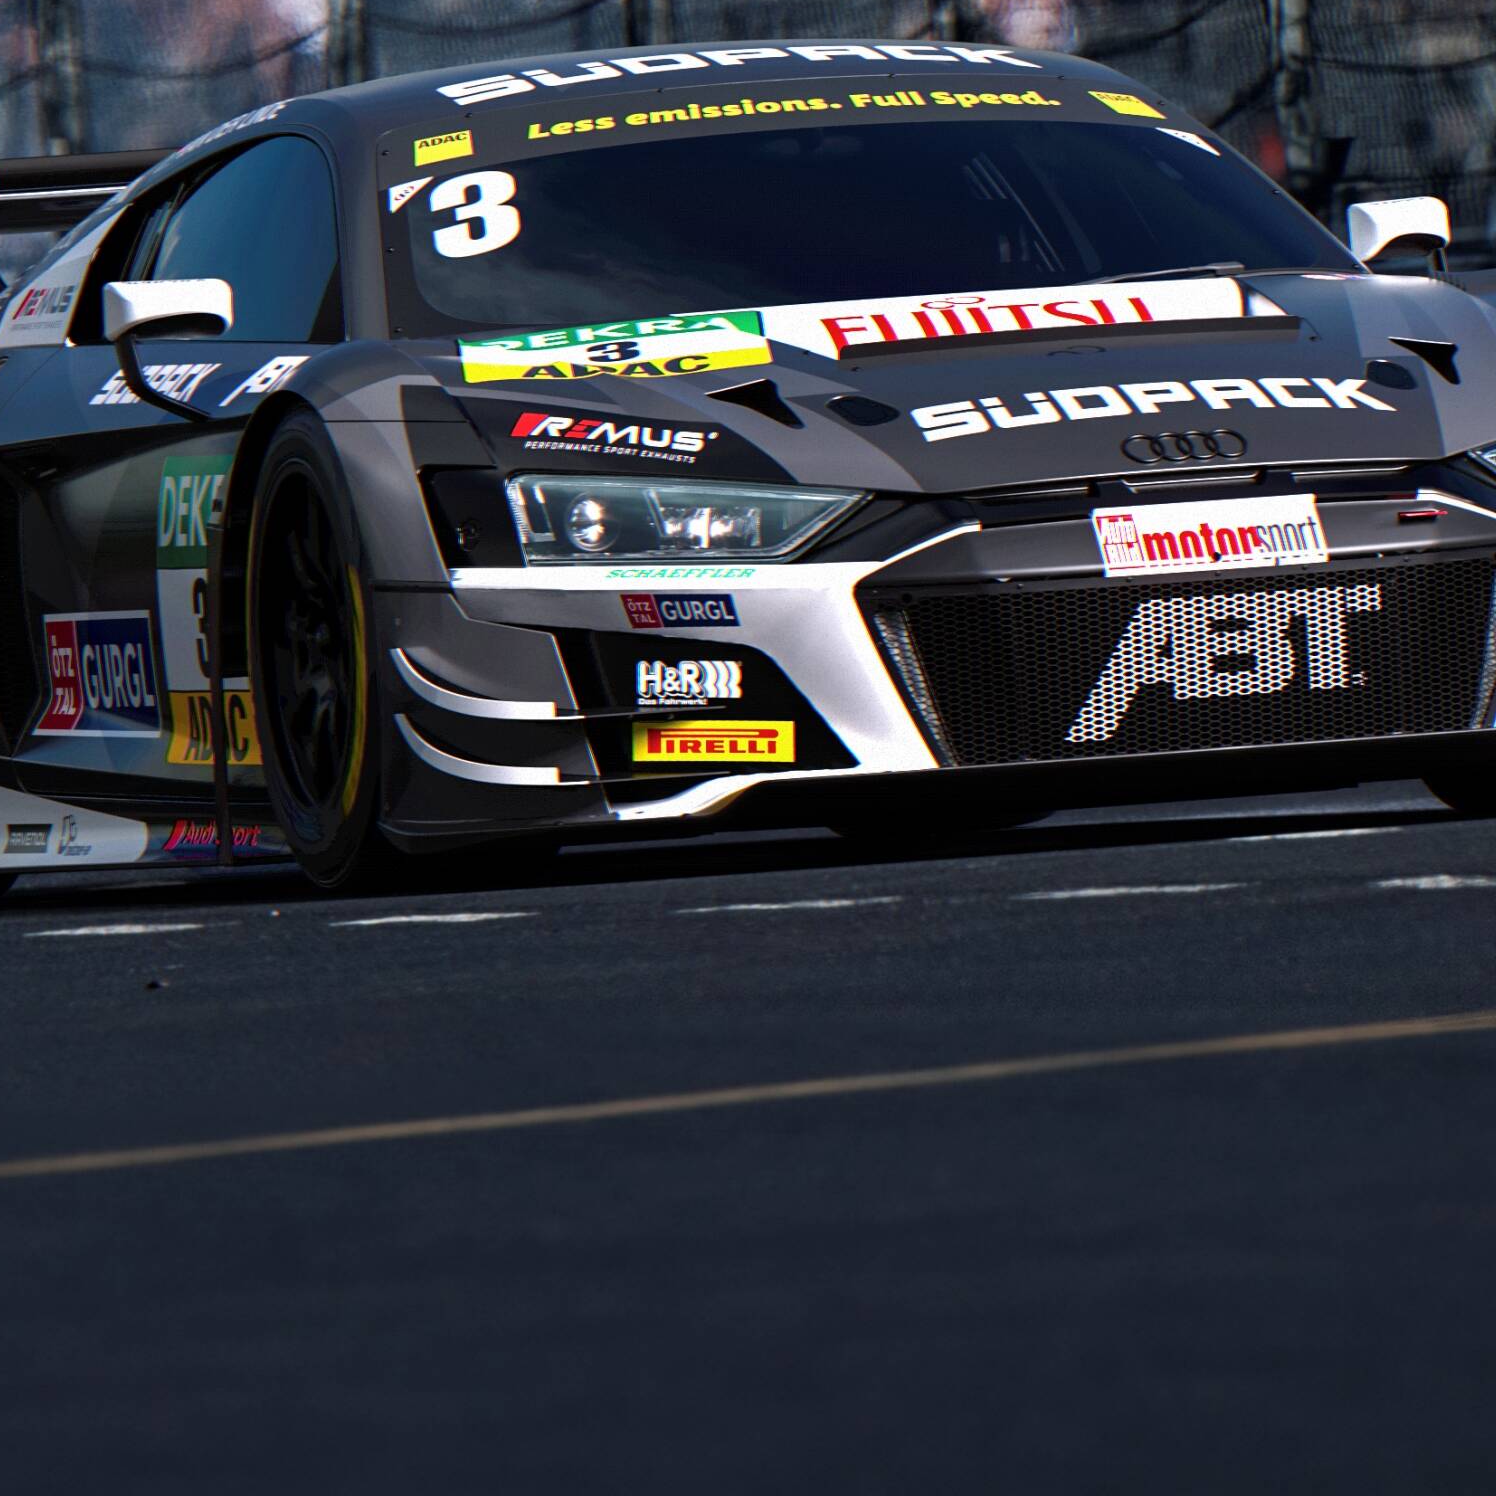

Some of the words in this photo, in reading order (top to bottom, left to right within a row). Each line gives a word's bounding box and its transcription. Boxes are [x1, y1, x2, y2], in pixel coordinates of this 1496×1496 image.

[528, 116, 616, 139] Less
[625, 97, 843, 125] emissions.
[849, 90, 927, 108] Full
[929, 90, 1061, 109] Speed.
[418, 132, 468, 149] ADAC
[430, 170, 522, 258] 3
[586, 340, 642, 363] 3
[525, 440, 602, 454] PERFORMANCE
[605, 444, 638, 457] SPORT
[639, 446, 697, 464] EXHAUSTS
[606, 568, 756, 579] SCHAEFFLER
[627, 598, 652, 612] ÖTZ
[660, 600, 736, 621] GURGL
[632, 613, 657, 624] TAL
[81, 642, 156, 709] GURGL
[1064, 584, 1382, 743] ABT
[52, 687, 77, 716] TAL
[184, 692, 250, 762] ADC
[647, 728, 780, 754] PIRELLI
